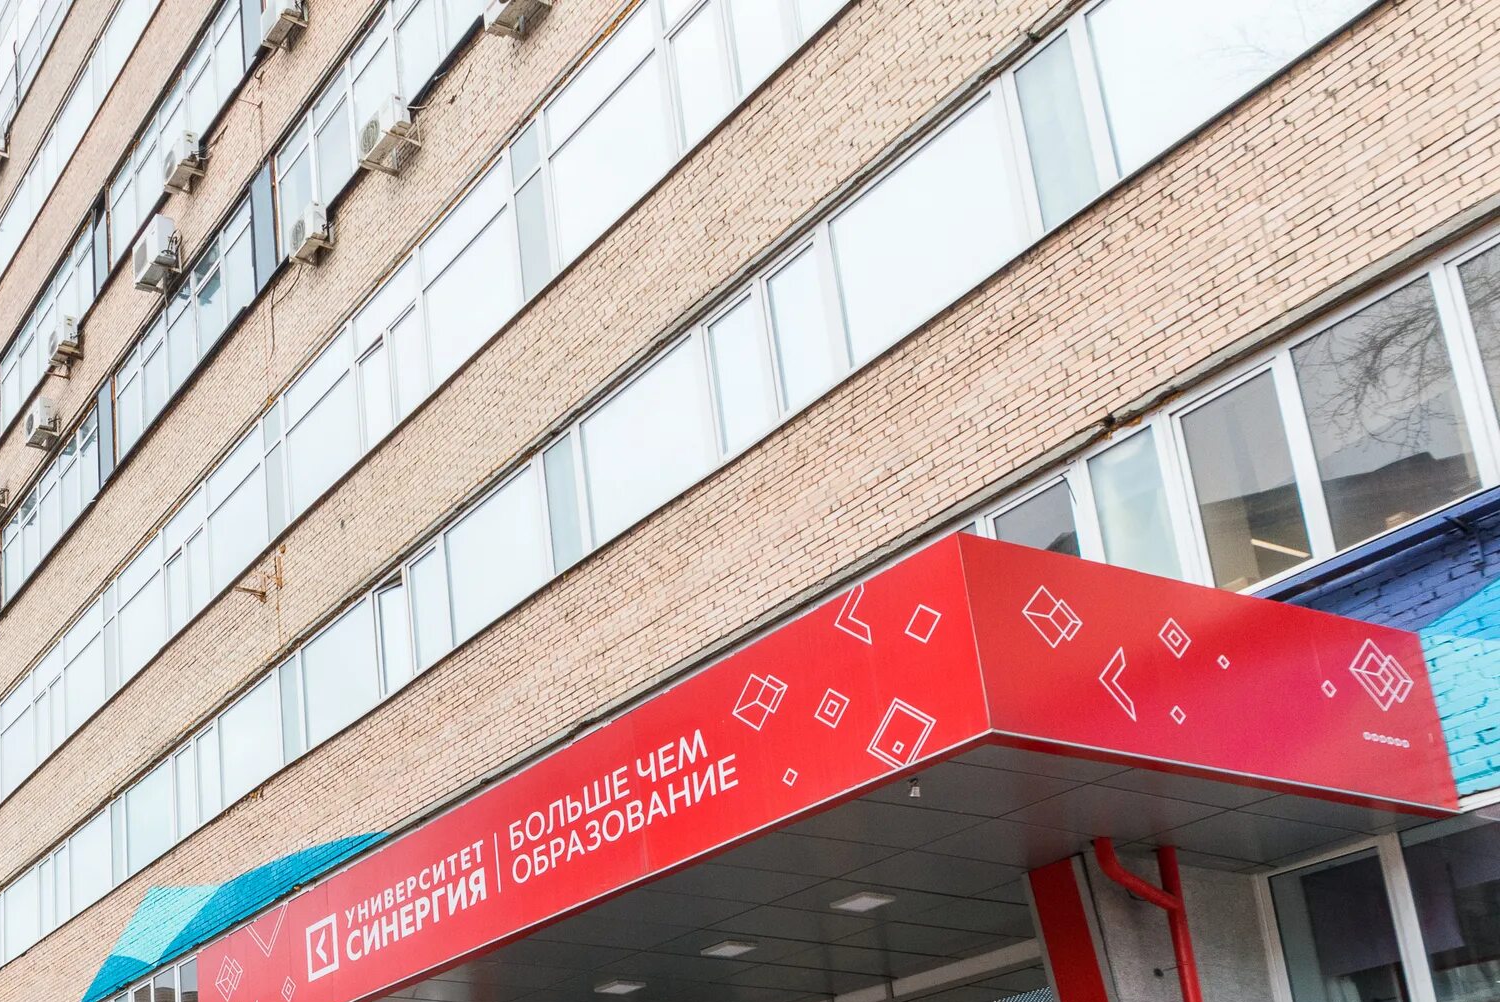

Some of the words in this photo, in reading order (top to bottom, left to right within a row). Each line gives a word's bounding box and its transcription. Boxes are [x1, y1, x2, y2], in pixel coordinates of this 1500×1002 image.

[508, 765, 630, 851] БОЛЬШЕ
[636, 729, 708, 783] ЧЕМ
[512, 753, 739, 884] ОБРАЗОВАНИЕ
[345, 839, 484, 929] УНИВЕРСИТЕТ
[346, 867, 487, 961] СИНЕРГИЯ
